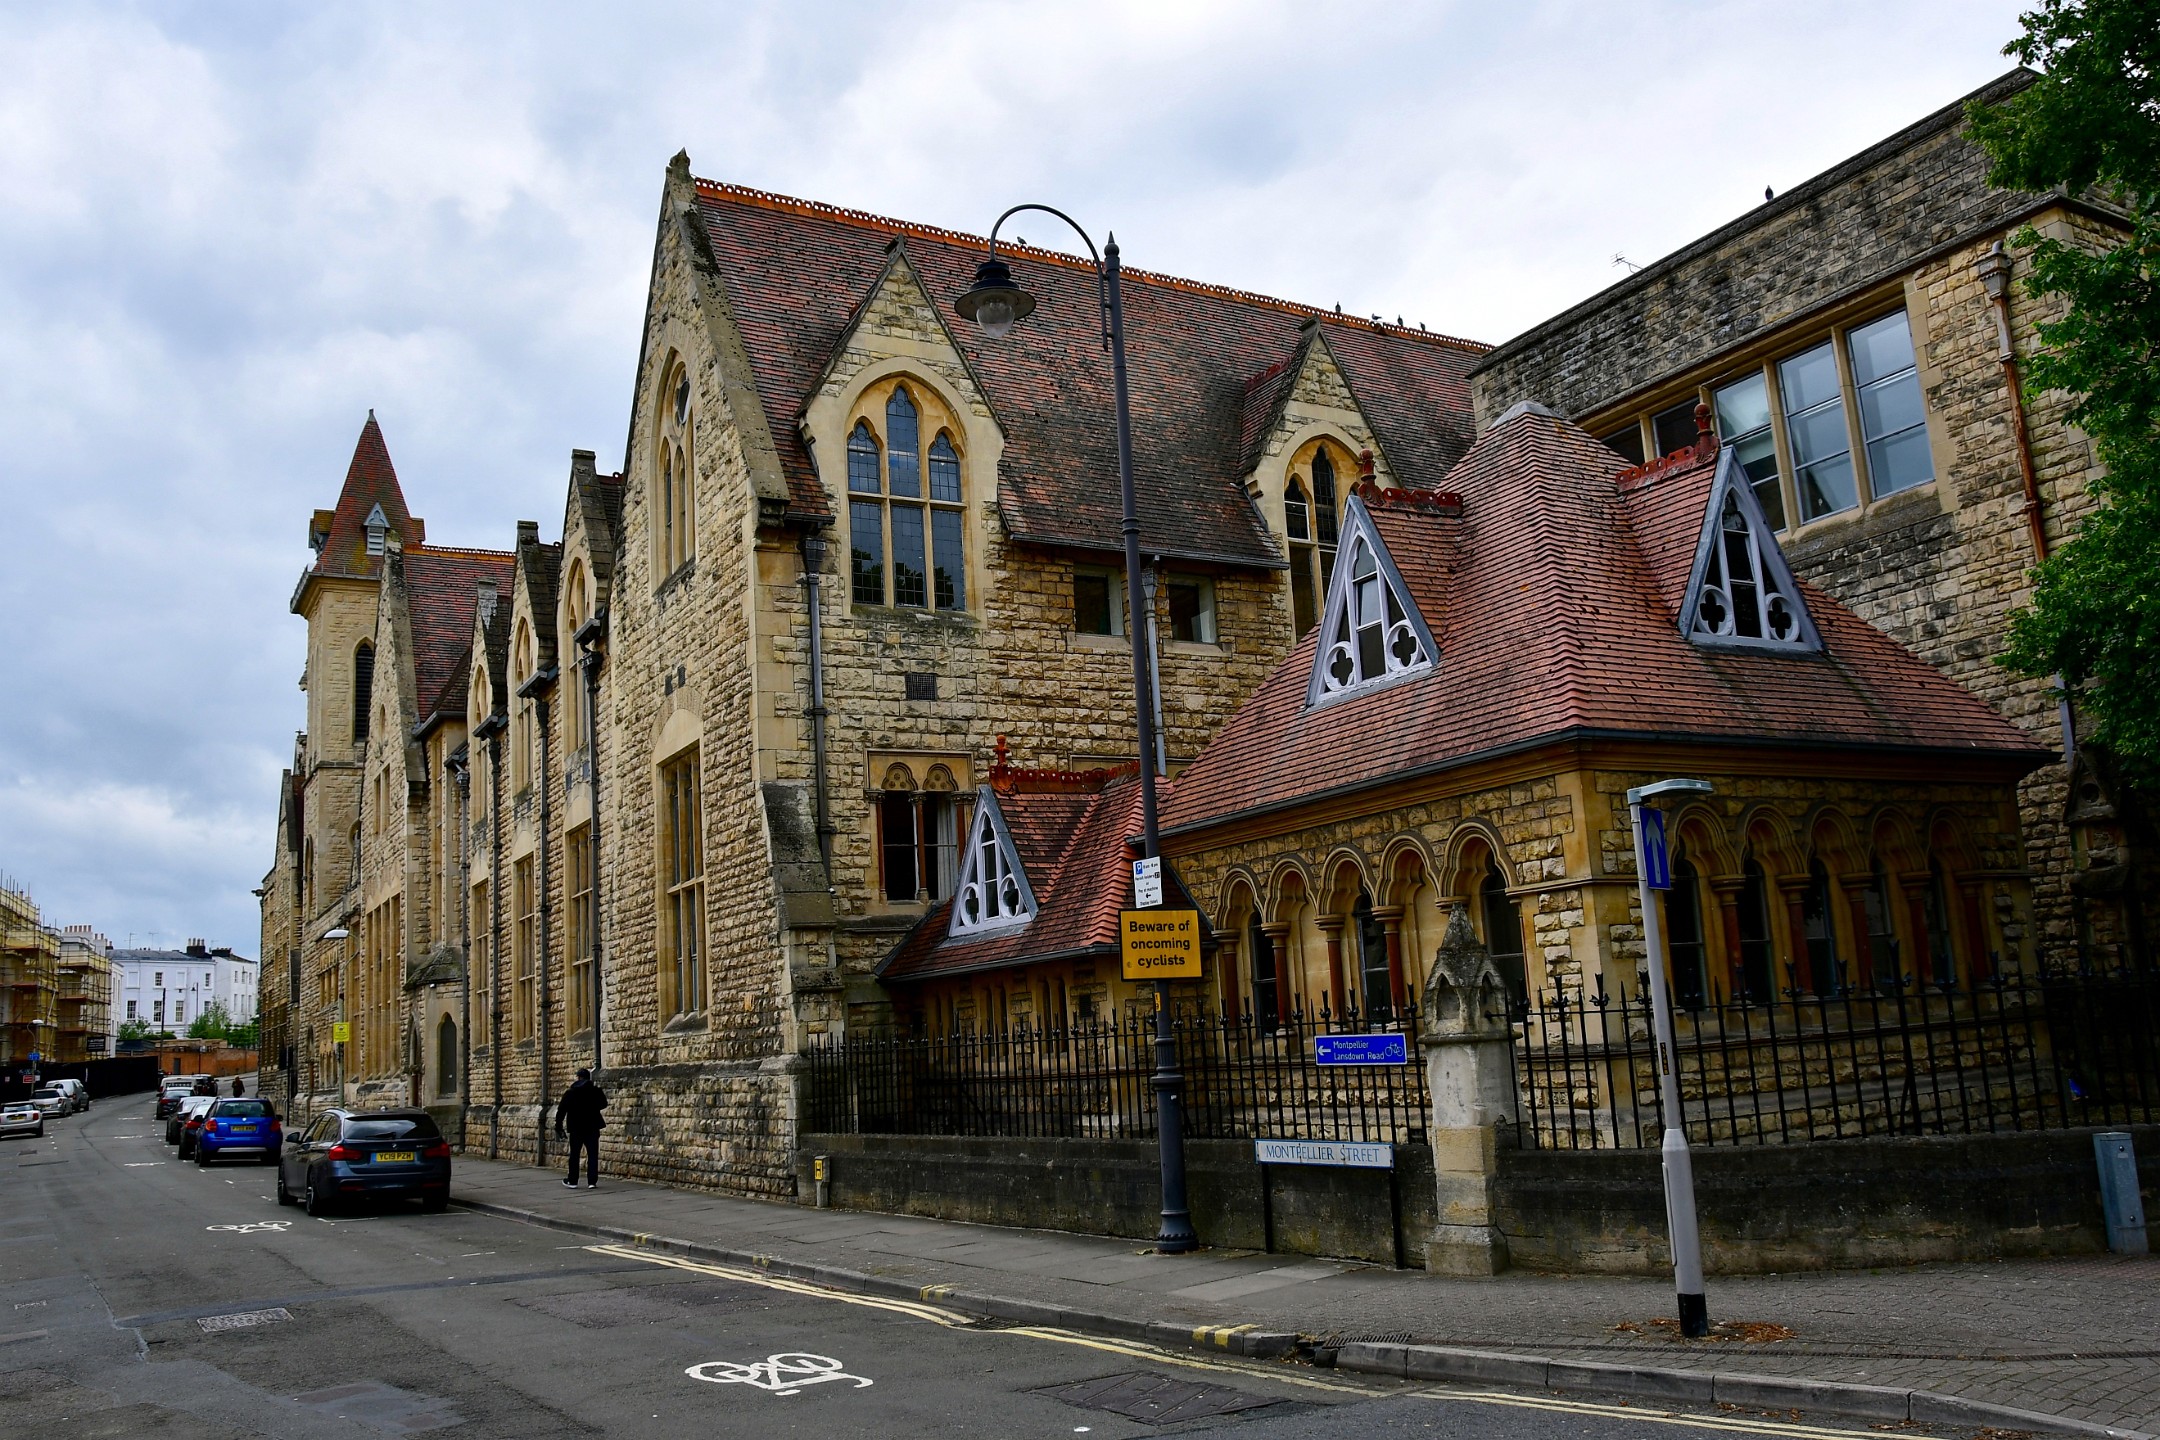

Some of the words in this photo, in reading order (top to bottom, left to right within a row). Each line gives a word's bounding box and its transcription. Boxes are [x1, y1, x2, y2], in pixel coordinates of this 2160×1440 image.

[1129, 921, 1175, 932] Beware
[1178, 920, 1190, 931] of
[1131, 938, 1190, 950] oncoming
[1138, 954, 1185, 968] cyclists
[1333, 1040, 1369, 1050] Montpellier
[1334, 1052, 1365, 1061] Lansdown
[1367, 1051, 1385, 1060] Road
[378, 1152, 395, 1160] YC19
[397, 1152, 411, 1160] PZH
[1266, 1144, 1335, 1161] MONTPELLIER
[1340, 1147, 1380, 1163] STREET
